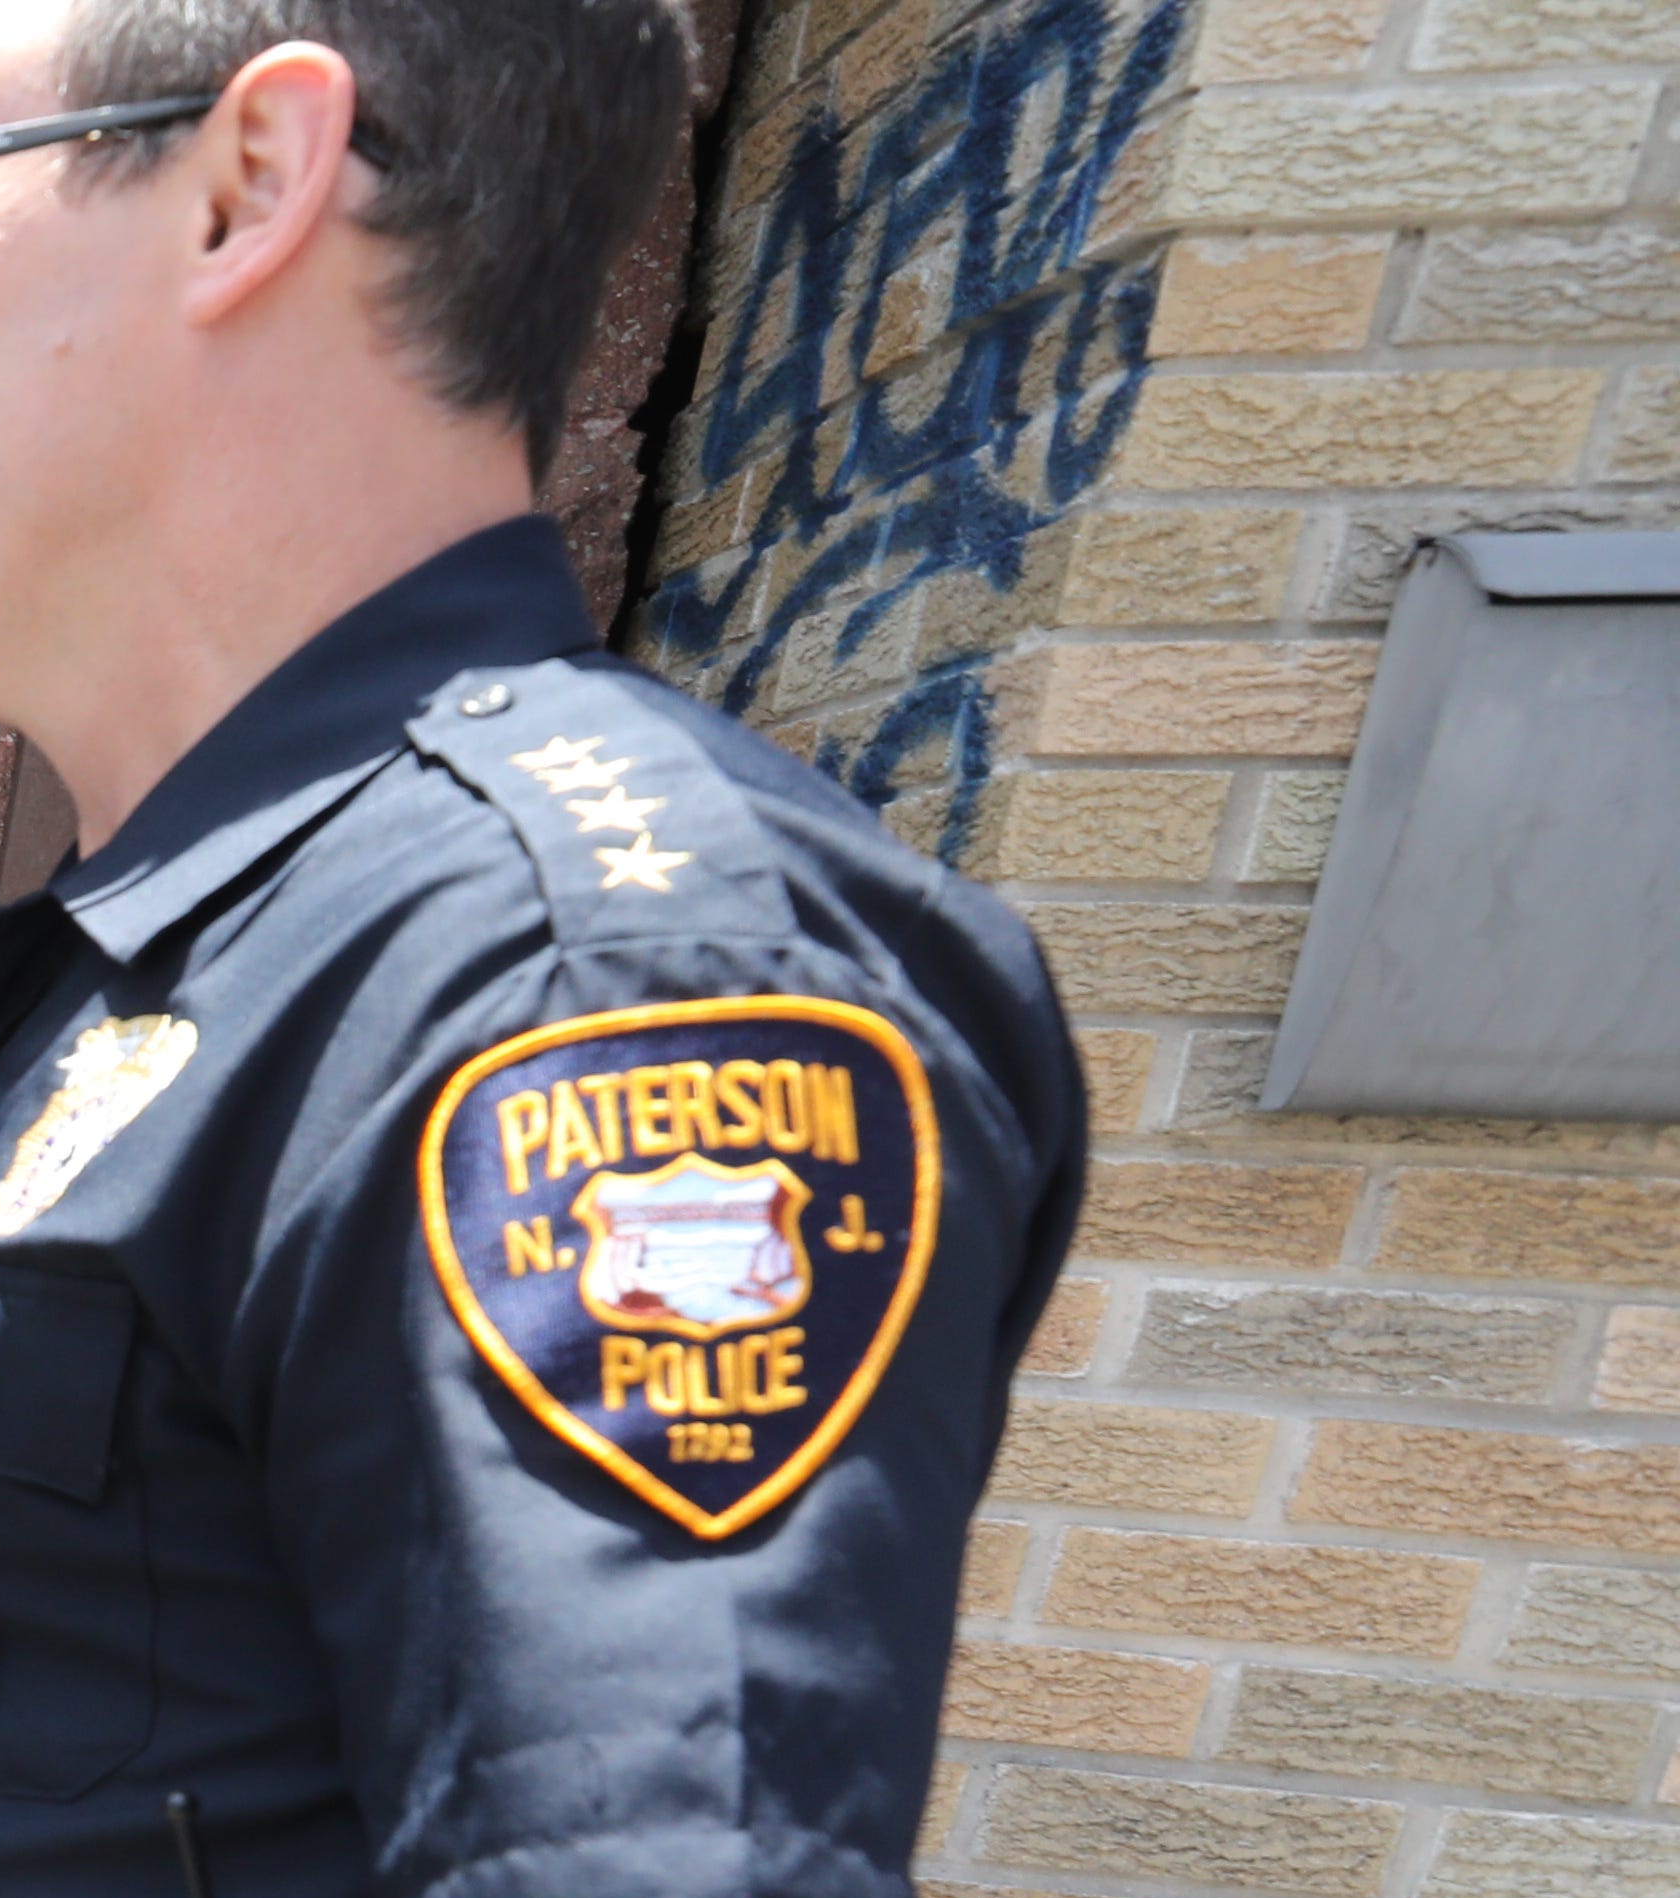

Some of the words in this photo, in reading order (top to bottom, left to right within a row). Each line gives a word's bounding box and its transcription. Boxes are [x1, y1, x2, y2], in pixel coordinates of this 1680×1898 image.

[497, 1058, 860, 1195] PATERSON
[503, 1215, 577, 1277] N.
[601, 1327, 808, 1416] POLICE
